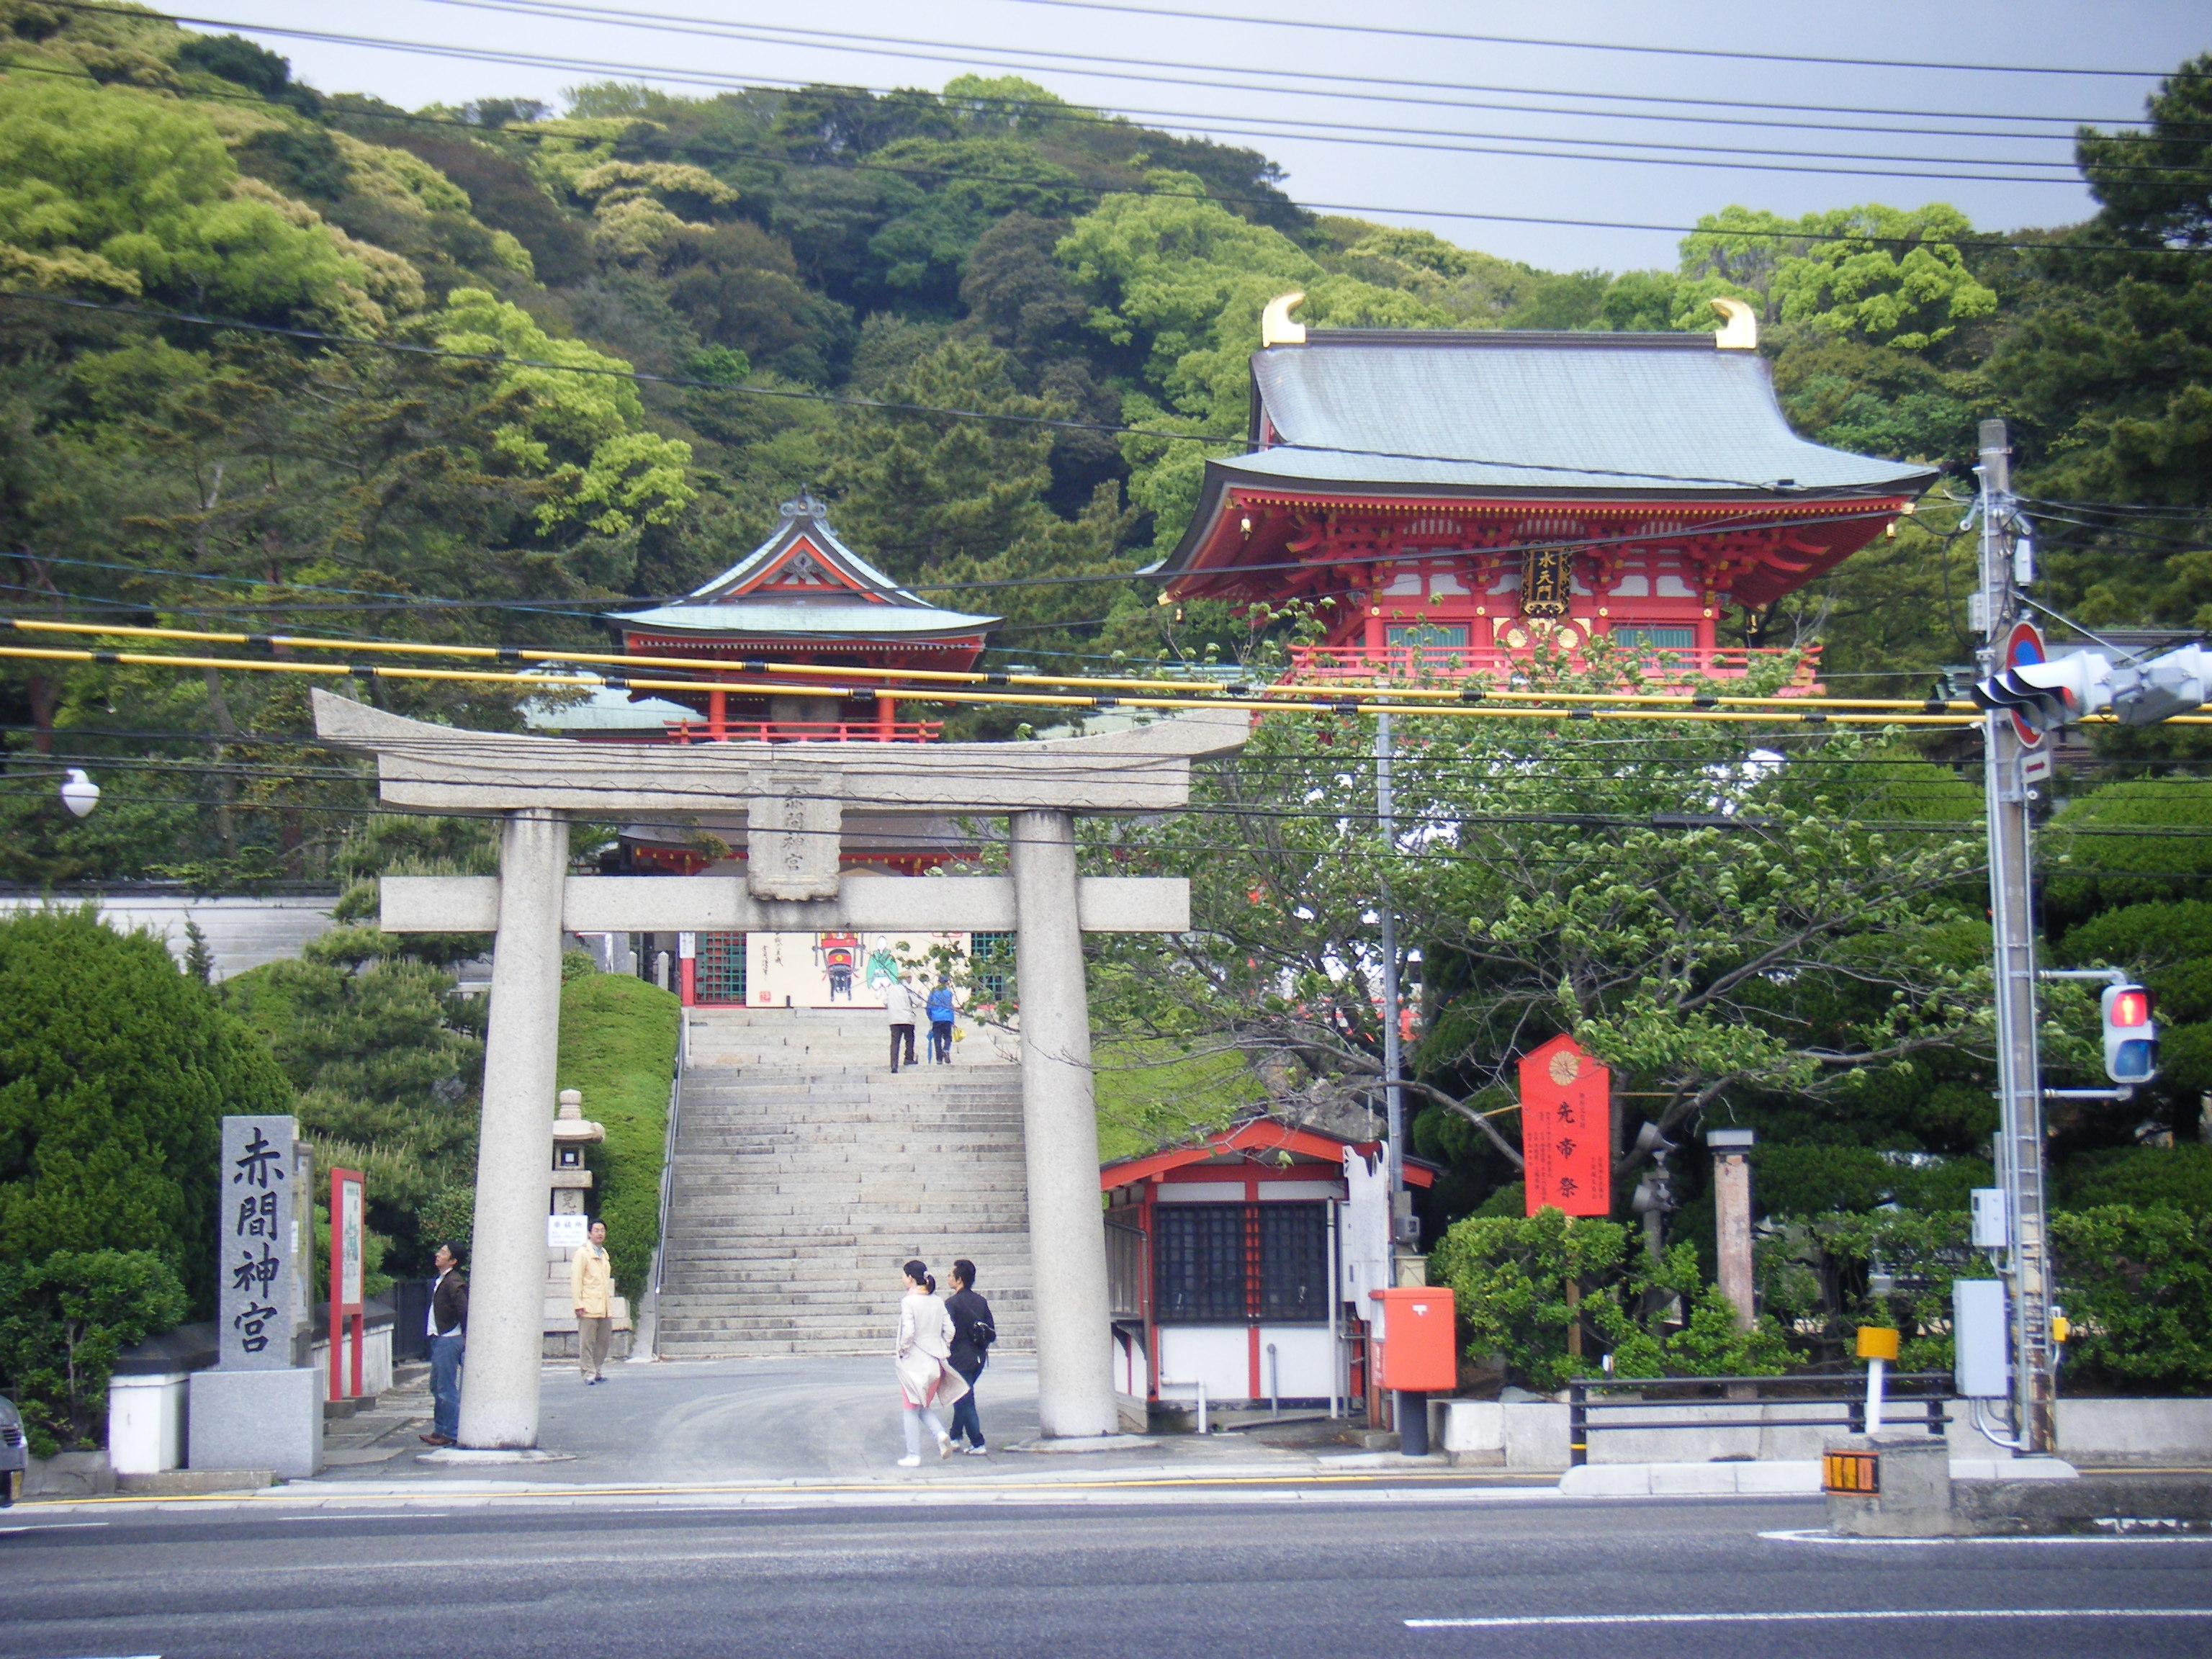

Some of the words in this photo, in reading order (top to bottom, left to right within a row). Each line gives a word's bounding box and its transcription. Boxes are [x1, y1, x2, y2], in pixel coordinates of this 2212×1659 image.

[1536, 552, 1557, 601] 水天門
[1556, 1101, 1578, 1199] 先帝祭
[233, 1127, 284, 1353] 赤間神宮
